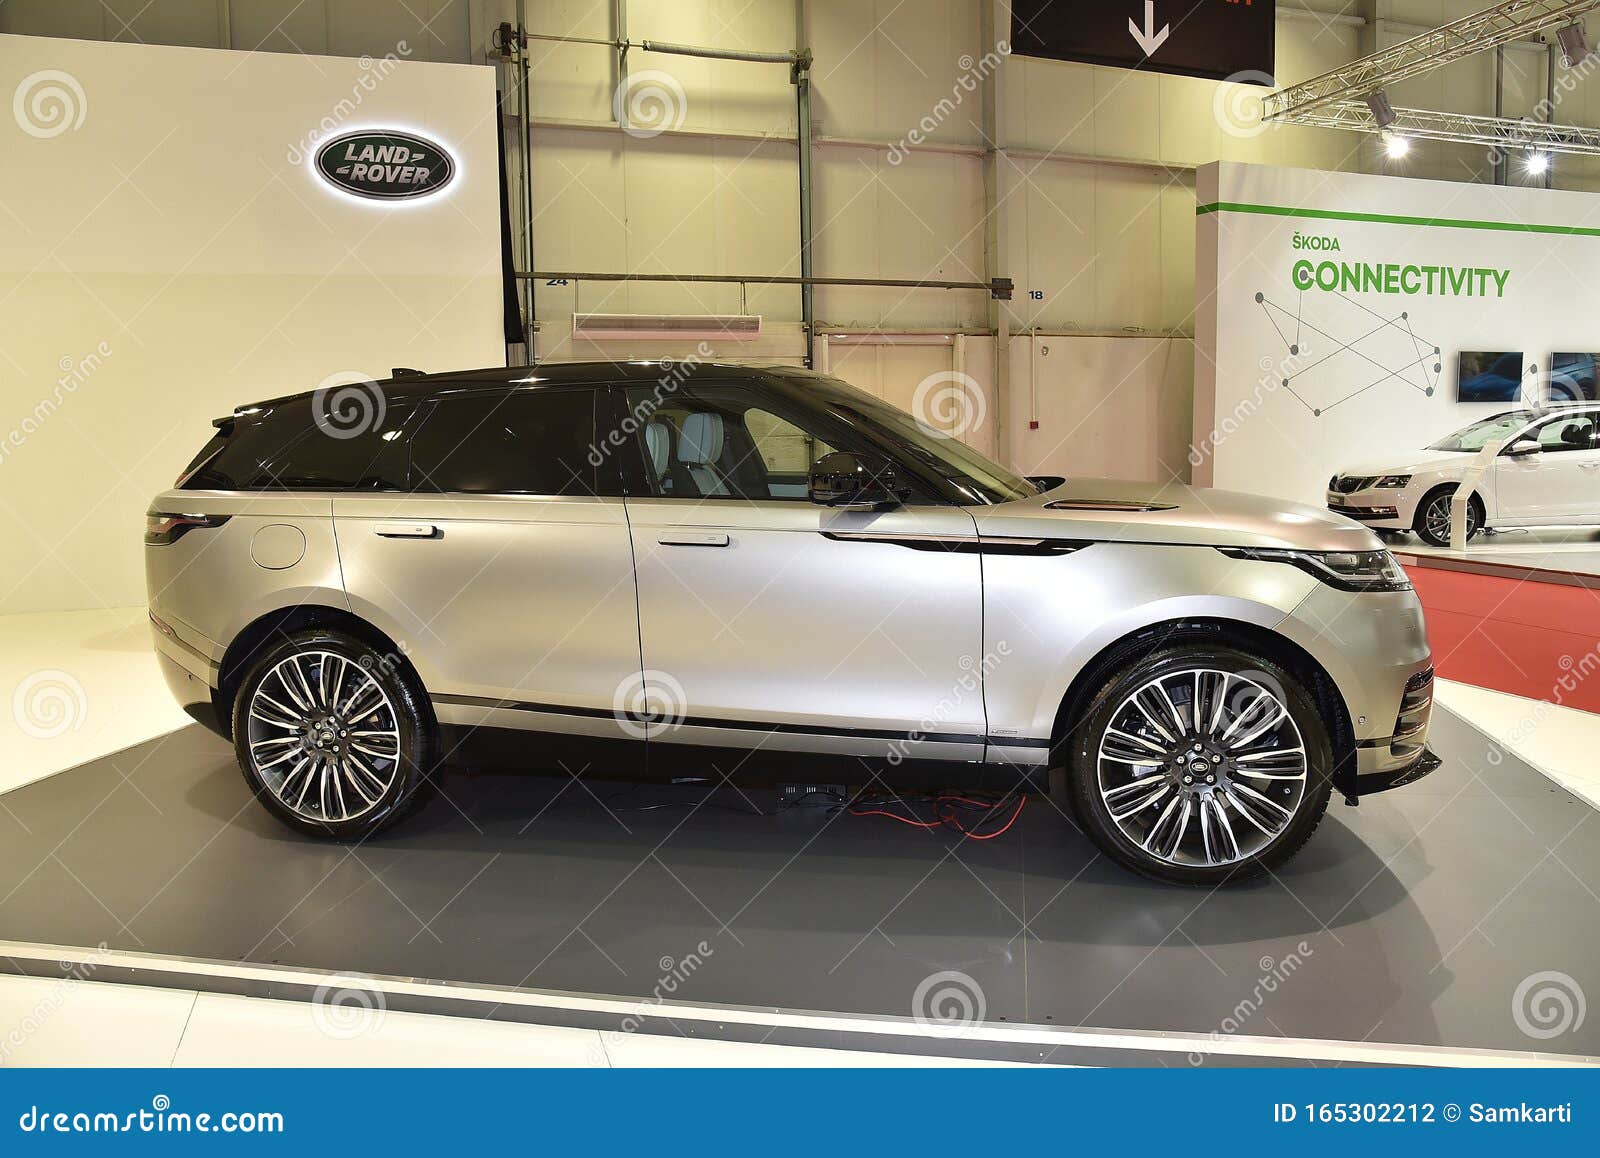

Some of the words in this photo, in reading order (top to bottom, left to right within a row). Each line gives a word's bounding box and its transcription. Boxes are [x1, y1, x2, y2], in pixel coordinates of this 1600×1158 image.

[345, 143, 410, 164] LAND
[350, 163, 430, 184] ROVER
[1292, 231, 1341, 251] ŠKODA
[1292, 259, 1511, 298] CONNECTIVITY
[1028, 290, 1043, 300] 18
